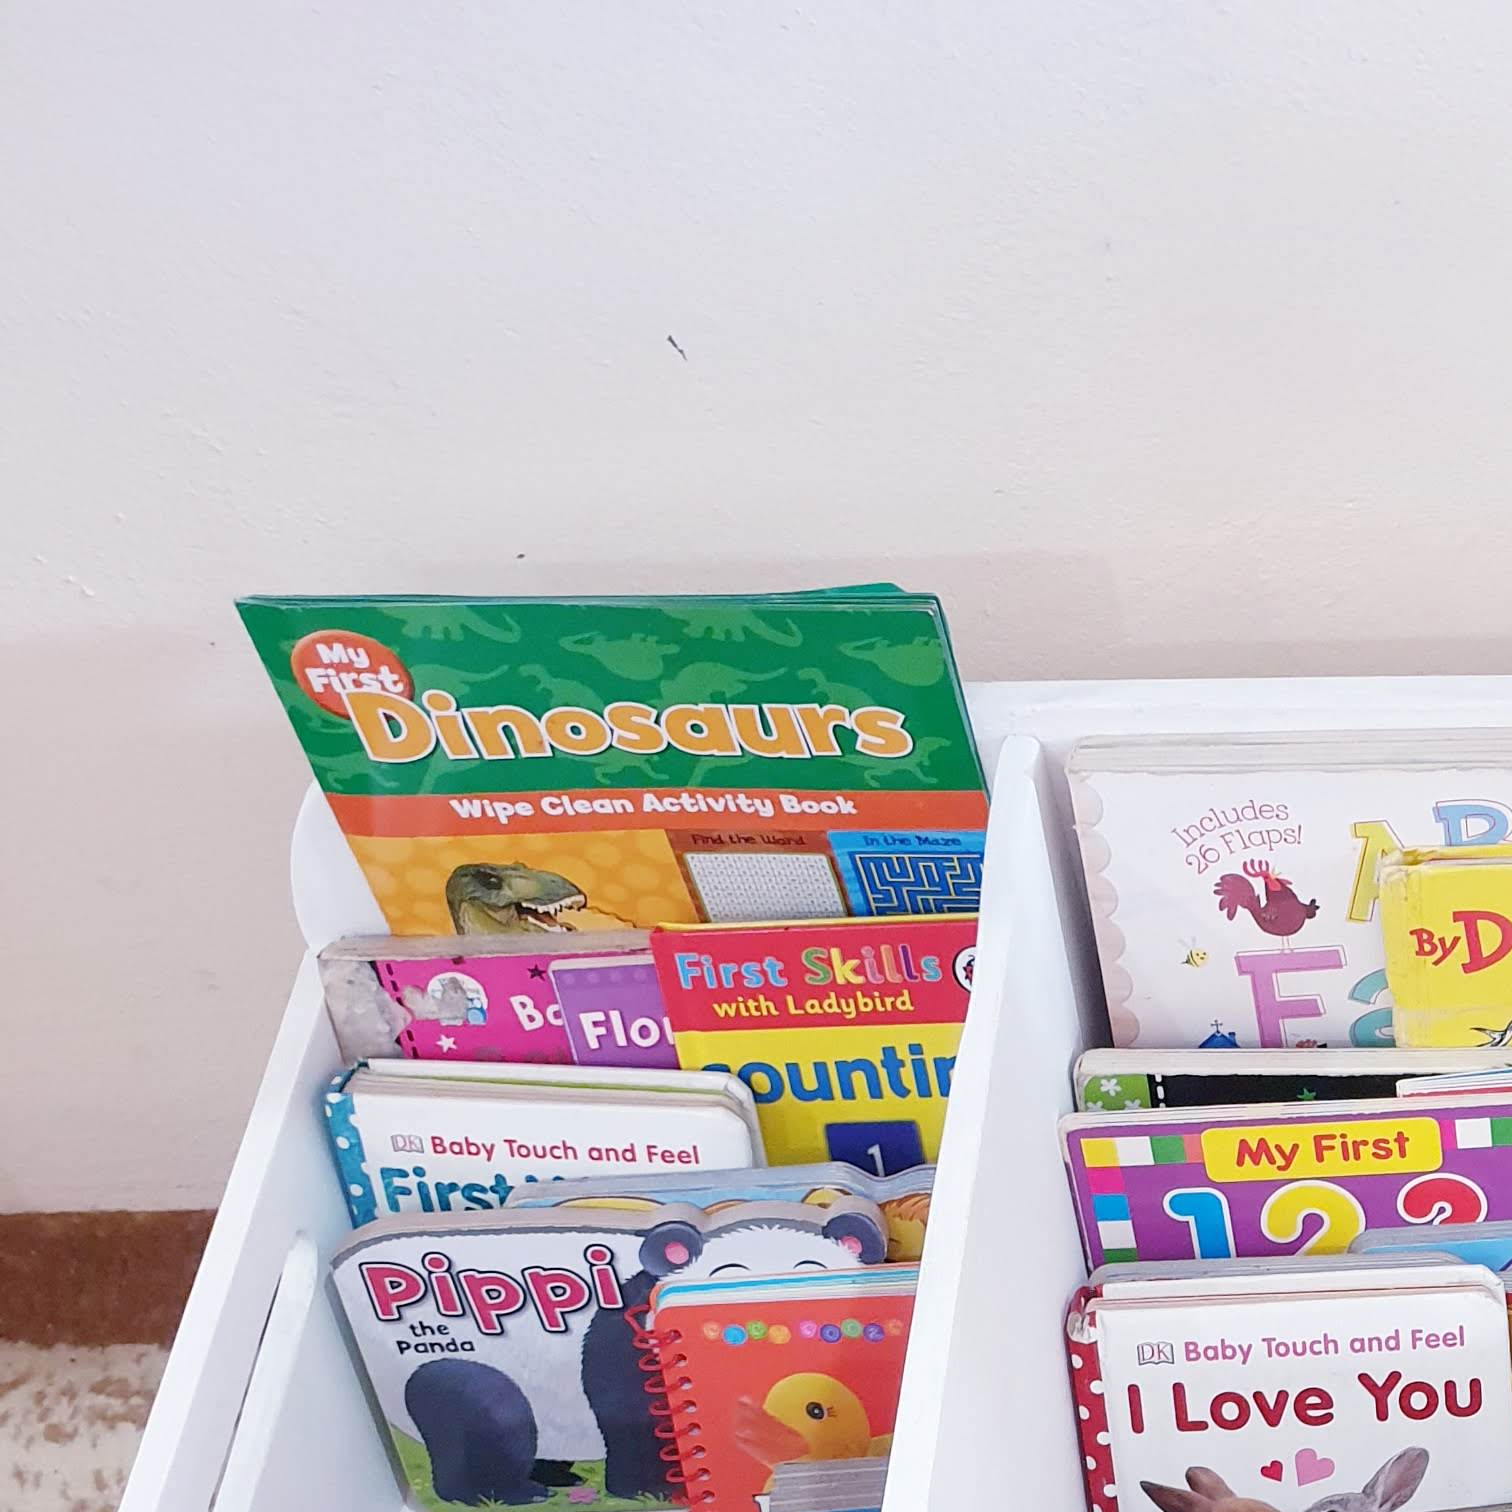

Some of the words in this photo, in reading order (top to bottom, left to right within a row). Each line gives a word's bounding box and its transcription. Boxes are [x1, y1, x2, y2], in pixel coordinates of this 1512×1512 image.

[316, 643, 370, 668] My
[304, 665, 404, 694] First
[341, 689, 914, 764] Dinosaurs
[449, 797, 535, 825] Wipe
[541, 794, 635, 817] Clean
[643, 793, 775, 817] Activity
[779, 793, 858, 815] Book
[1170, 799, 1290, 849] Includes
[690, 833, 725, 846] Find
[728, 834, 757, 845] the
[760, 833, 807, 846] Word
[862, 834, 882, 846] In
[884, 834, 912, 847] the
[915, 834, 962, 847] Maze
[1185, 843, 1221, 875] 26
[1220, 824, 1303, 855] Flaps!
[1409, 927, 1461, 967] By
[674, 953, 788, 990] First
[800, 943, 943, 985] Skills
[712, 993, 780, 1018] with
[785, 989, 915, 1019] Ladybird
[430, 1136, 496, 1162] Baby
[503, 1138, 578, 1160] Touch
[588, 1143, 637, 1163] and
[647, 1145, 700, 1164] Feel
[866, 1143, 886, 1177] 1
[1234, 1137, 1300, 1172] My
[1312, 1130, 1411, 1164] First
[379, 1166, 515, 1213] First
[359, 1243, 624, 1335] Pippi
[396, 1337, 476, 1355] Panda
[409, 1320, 450, 1338] the
[1139, 1343, 1173, 1363] DK
[1184, 1339, 1253, 1365] Baby
[1261, 1333, 1339, 1359] Touch
[1349, 1329, 1401, 1354] and
[1411, 1325, 1466, 1350] Feel
[1127, 1383, 1145, 1435] I
[1172, 1382, 1335, 1432] Love
[1357, 1370, 1483, 1422] You
